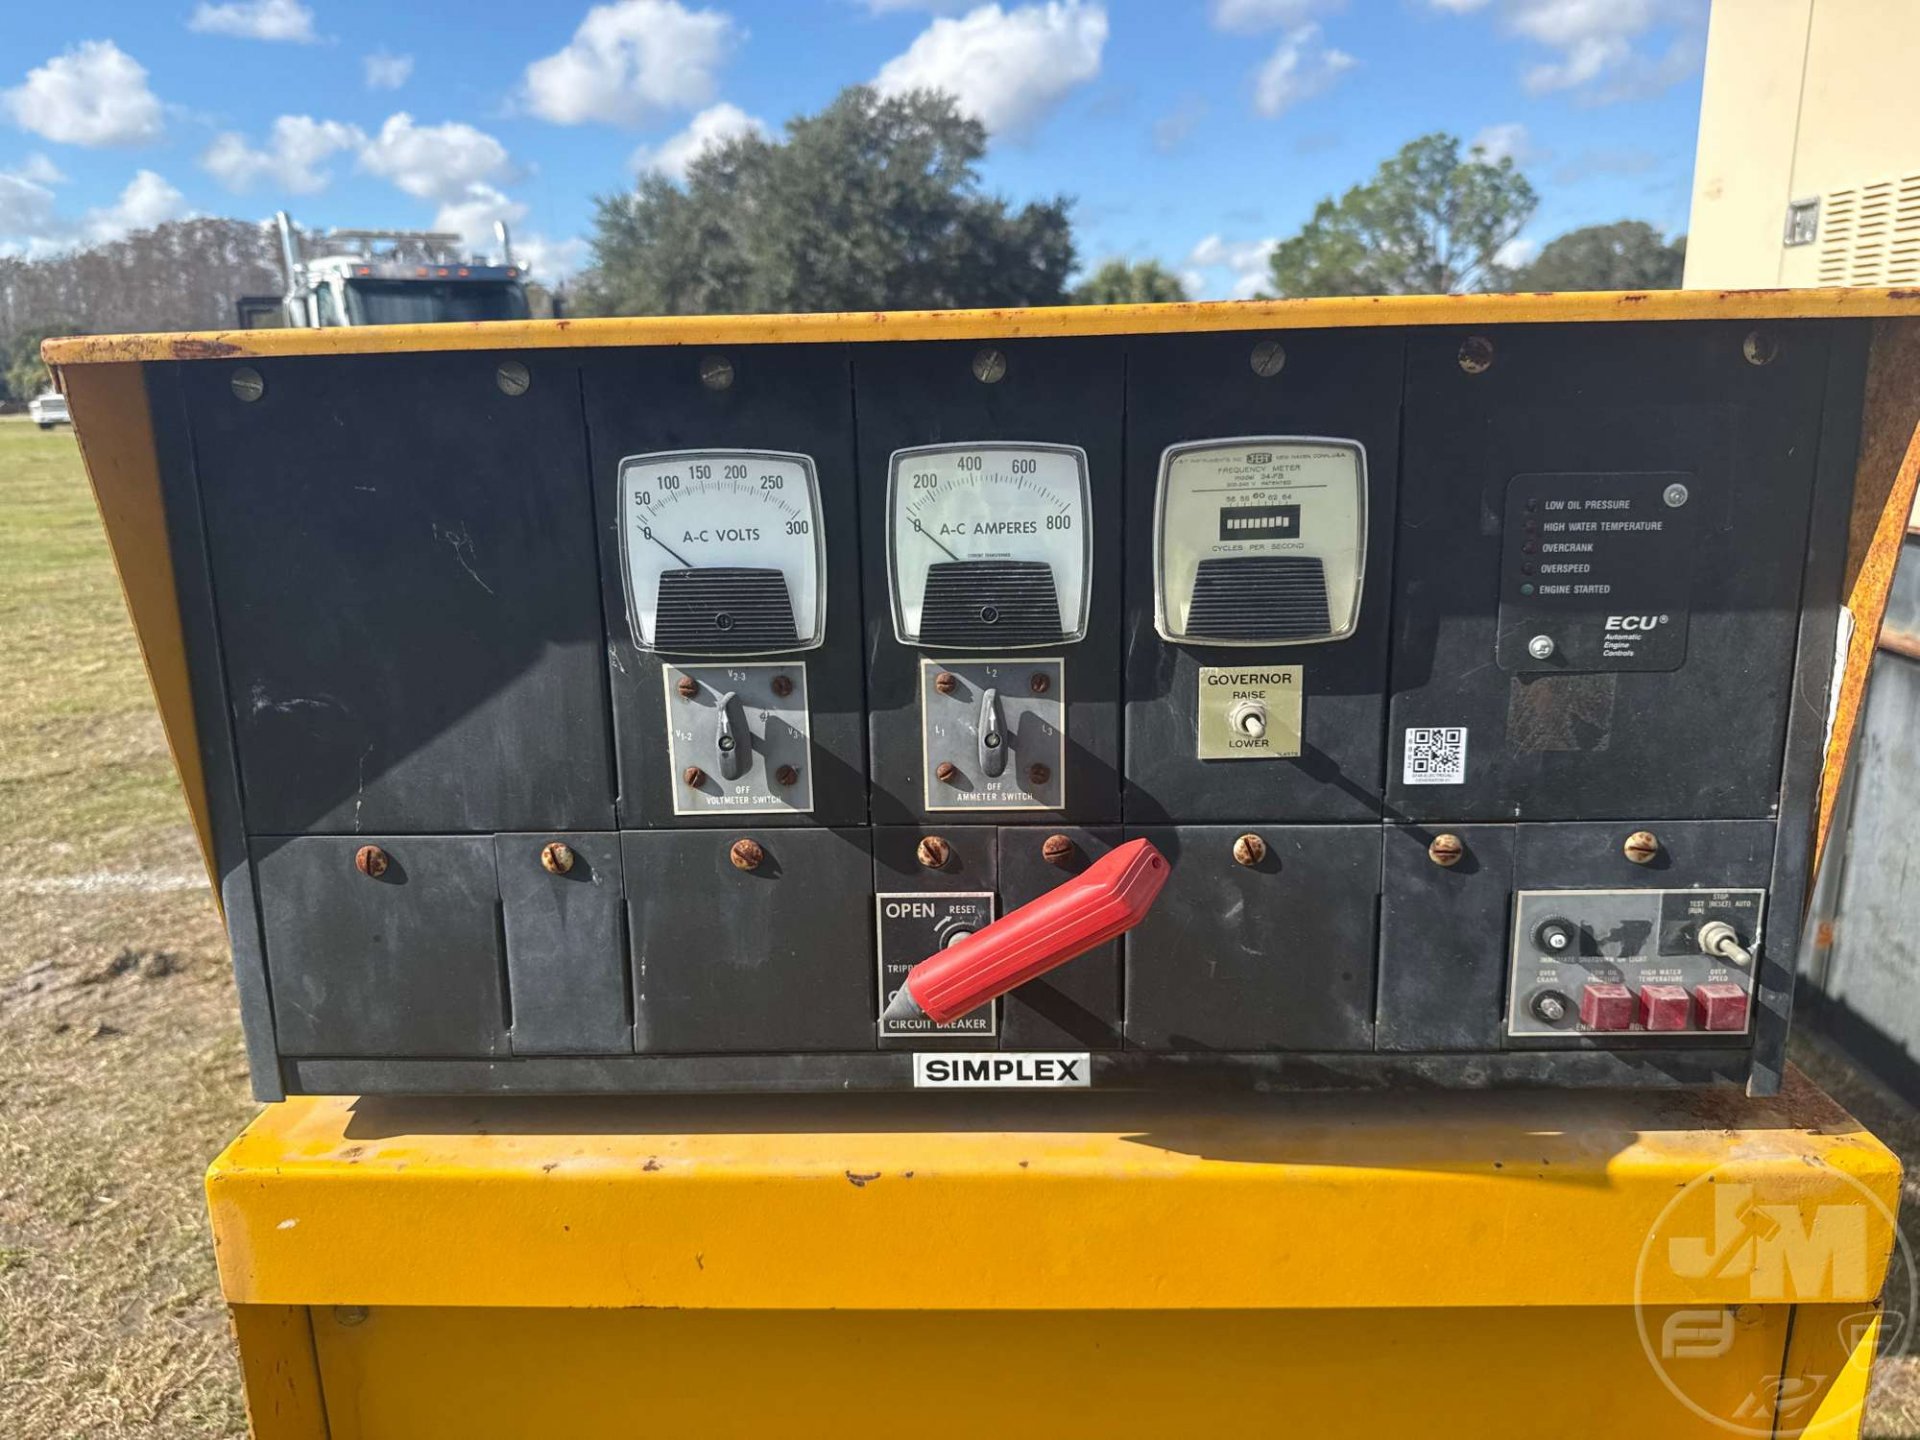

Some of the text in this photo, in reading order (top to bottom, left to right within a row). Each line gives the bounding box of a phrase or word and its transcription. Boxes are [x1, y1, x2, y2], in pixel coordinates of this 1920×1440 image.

[957, 456, 982, 471] 400
[1012, 459, 1036, 474] 600
[689, 466, 712, 480] 150
[724, 465, 747, 479] 200
[657, 476, 680, 490] 100
[760, 476, 783, 490] 250
[913, 474, 937, 489] 200
[634, 491, 651, 505] 50
[1545, 500, 1630, 510] LOW OIL PRESSURE
[786, 520, 809, 535] 300
[914, 519, 922, 533] 0
[940, 521, 1037, 535] A-C AMPERES
[1046, 515, 1071, 530] 800
[1543, 521, 1663, 532] HIGH WATER TEMPERATURE
[644, 526, 652, 540] 0
[683, 528, 760, 543] A-C VOLTS
[1542, 543, 1594, 552] OVERCRANK
[1541, 564, 1590, 573] OVERSPEED
[1539, 584, 1610, 594] ENGINE STARTED
[1603, 641, 1630, 649] Engine
[1207, 673, 1292, 686] GOVERNOR
[1232, 690, 1266, 699] RAISE
[1229, 739, 1269, 748] LOWER
[735, 786, 750, 794] OFF
[987, 783, 1002, 791] OFF
[706, 795, 782, 805] VOLTMETER SWITCH
[957, 792, 1033, 801] AMMETER SWITCH
[886, 903, 935, 918] OPEN
[949, 905, 976, 914] RESET
[888, 1019, 931, 1029] CIRCUIT
[926, 1059, 1079, 1082] SIMPLEX
